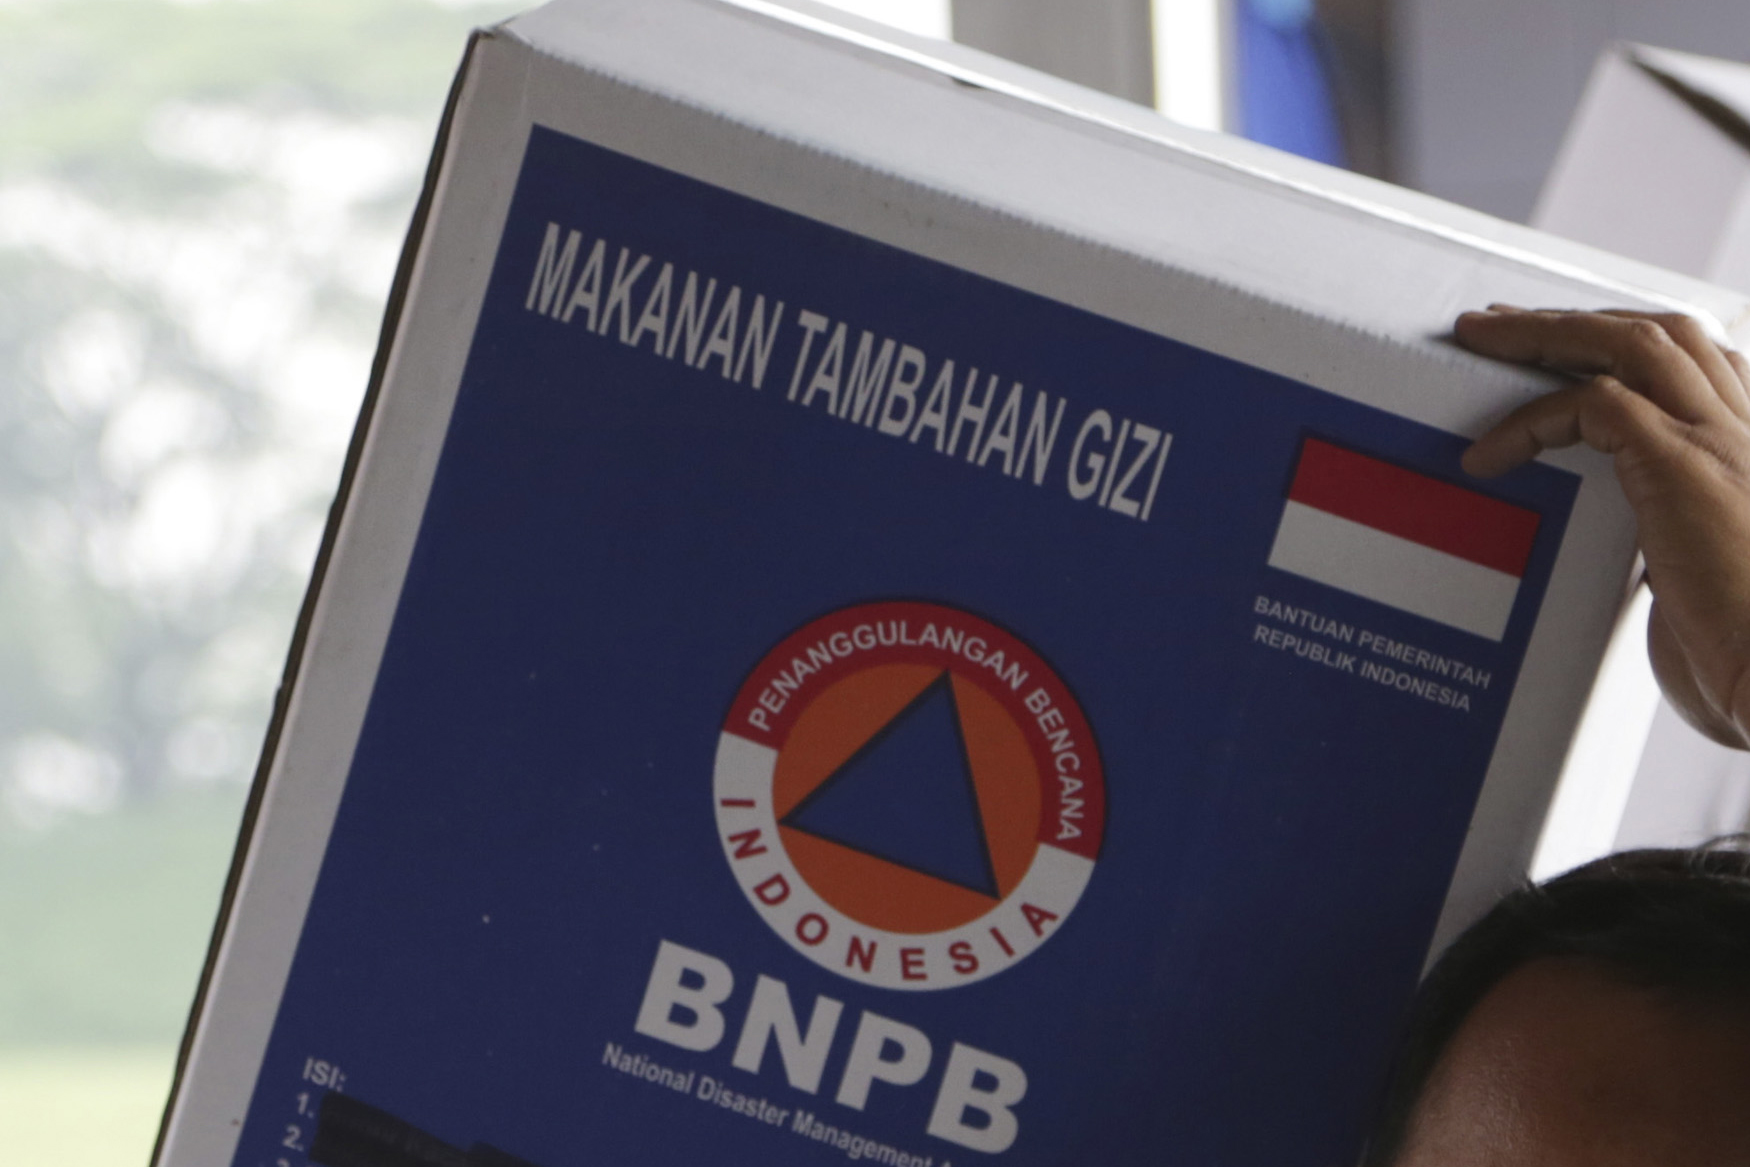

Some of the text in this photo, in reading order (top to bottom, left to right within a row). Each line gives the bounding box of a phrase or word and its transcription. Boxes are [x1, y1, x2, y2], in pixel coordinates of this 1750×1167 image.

[526, 222, 1172, 521] MAKANAN TAMBAHAN GIZI
[1254, 596, 1491, 689] BANTUAN PEMERINTAH
[1254, 624, 1470, 712] REPUBLIK INDONESIA
[748, 620, 1085, 841] PENANGGULANGAN BENCANA
[720, 798, 1058, 981] INDONESIA
[303, 1057, 346, 1092] ISI:
[602, 1041, 694, 1094] National
[697, 1076, 789, 1127] Disaster
[634, 939, 1027, 1154] BNPB
[283, 1125, 304, 1151] 2.
[297, 1093, 314, 1118] 1.
